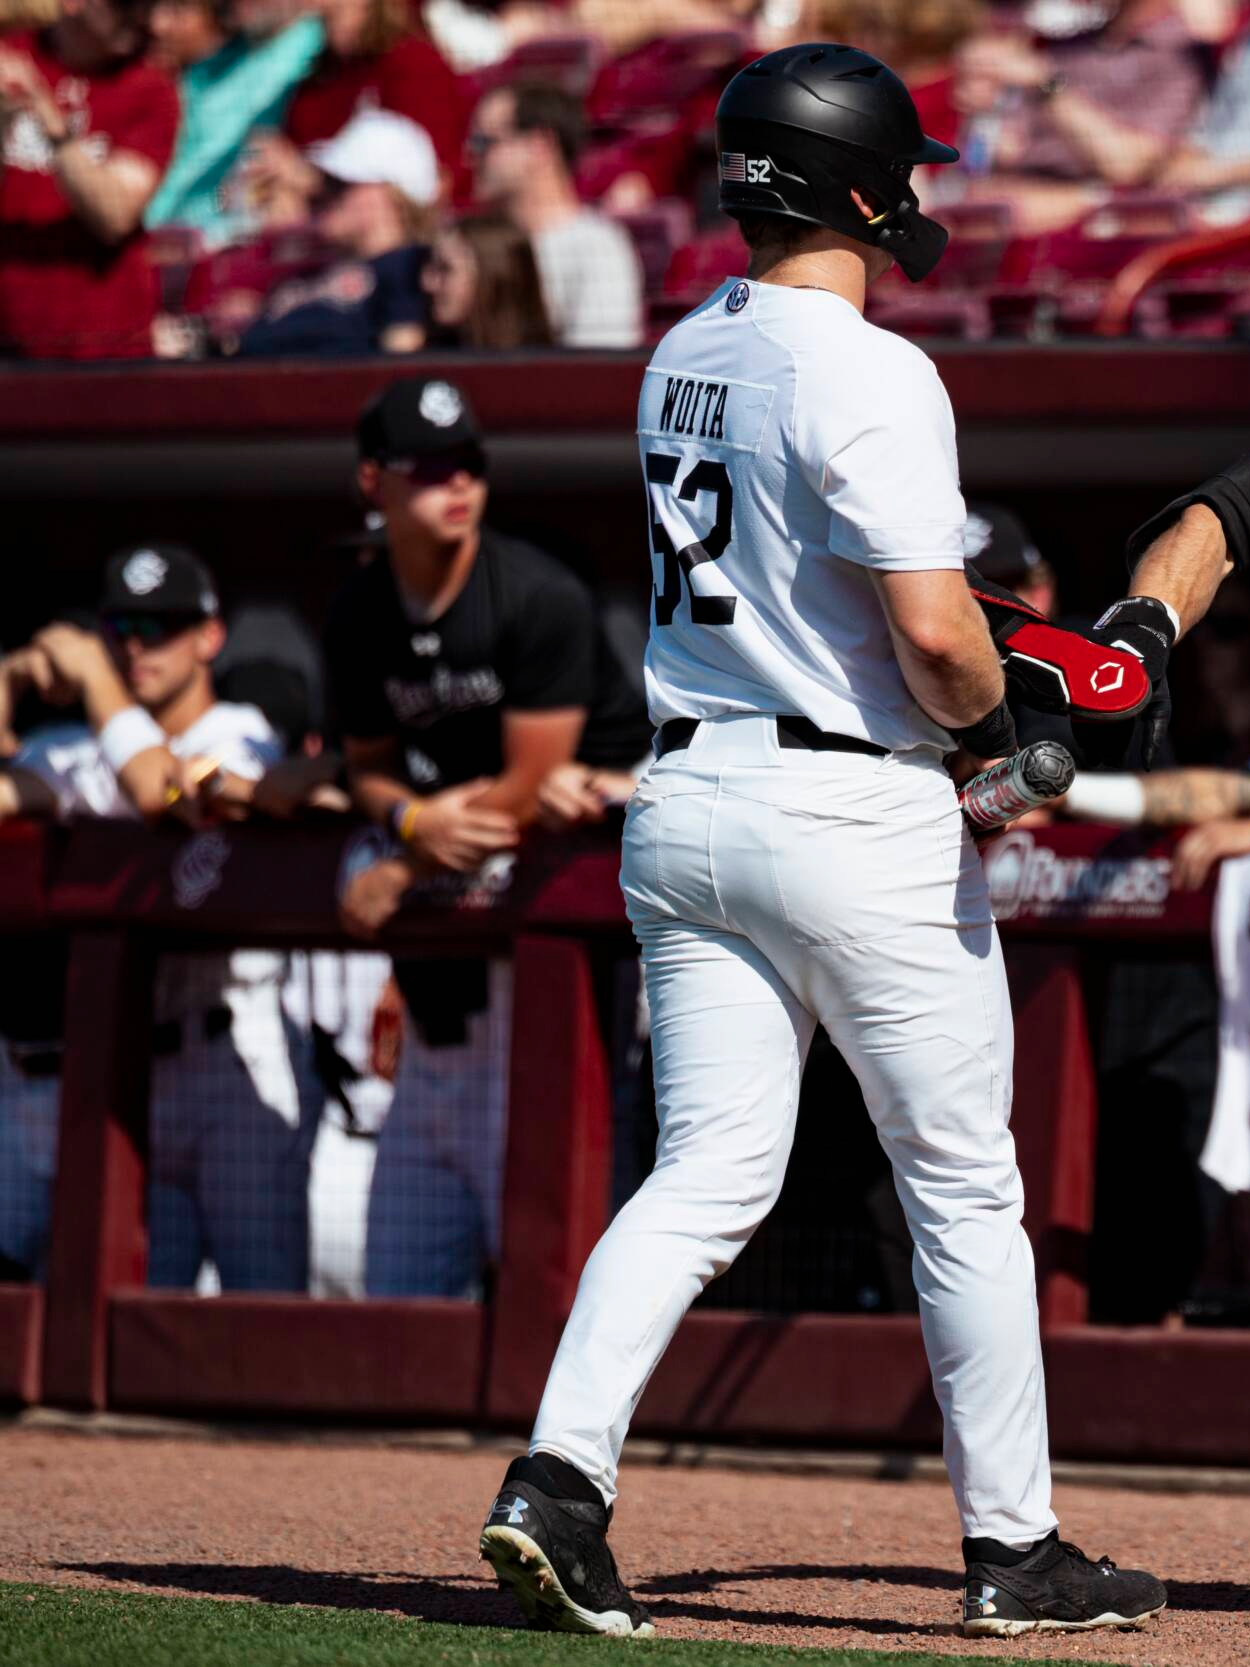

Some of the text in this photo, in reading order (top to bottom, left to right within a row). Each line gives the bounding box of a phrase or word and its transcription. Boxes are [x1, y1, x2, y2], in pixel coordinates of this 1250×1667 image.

[747, 159, 770, 183] 52
[660, 376, 729, 439] WOITA
[646, 452, 737, 626] 52
